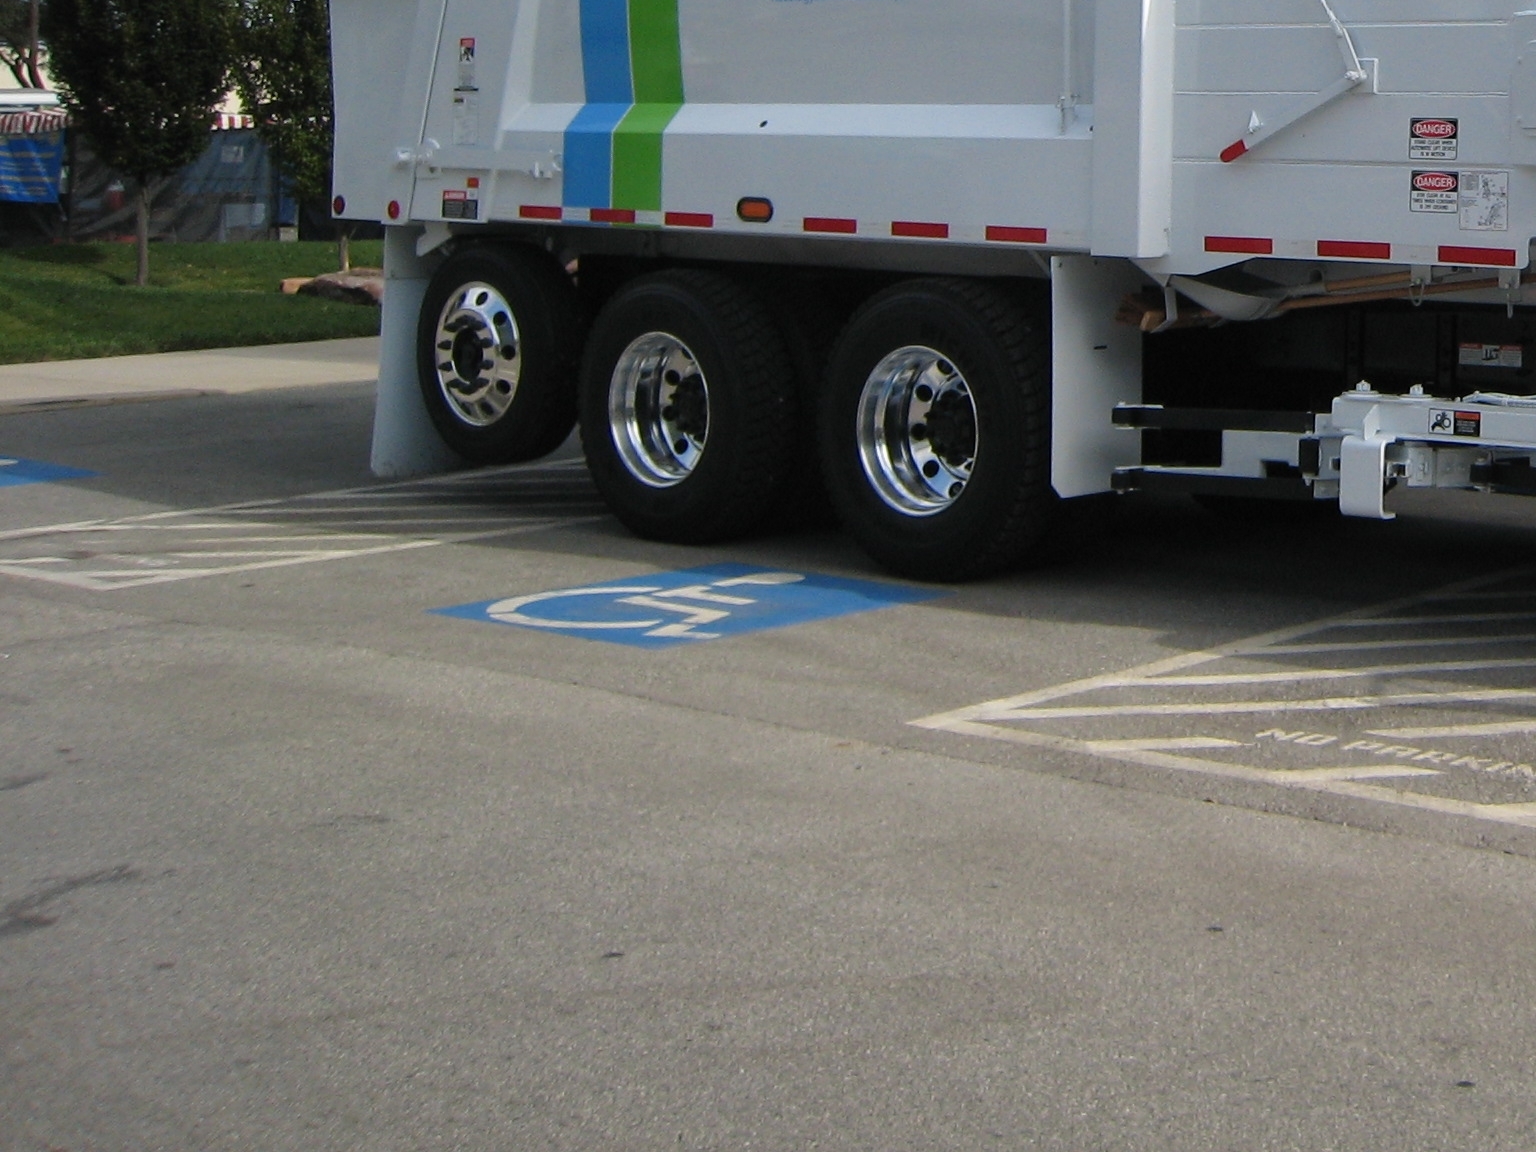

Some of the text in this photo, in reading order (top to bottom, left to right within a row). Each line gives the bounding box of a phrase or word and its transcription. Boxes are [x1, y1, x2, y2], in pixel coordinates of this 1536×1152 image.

[1416, 123, 1452, 134] DANGER
[1417, 177, 1453, 187] DANGER
[1255, 728, 1338, 746] NO
